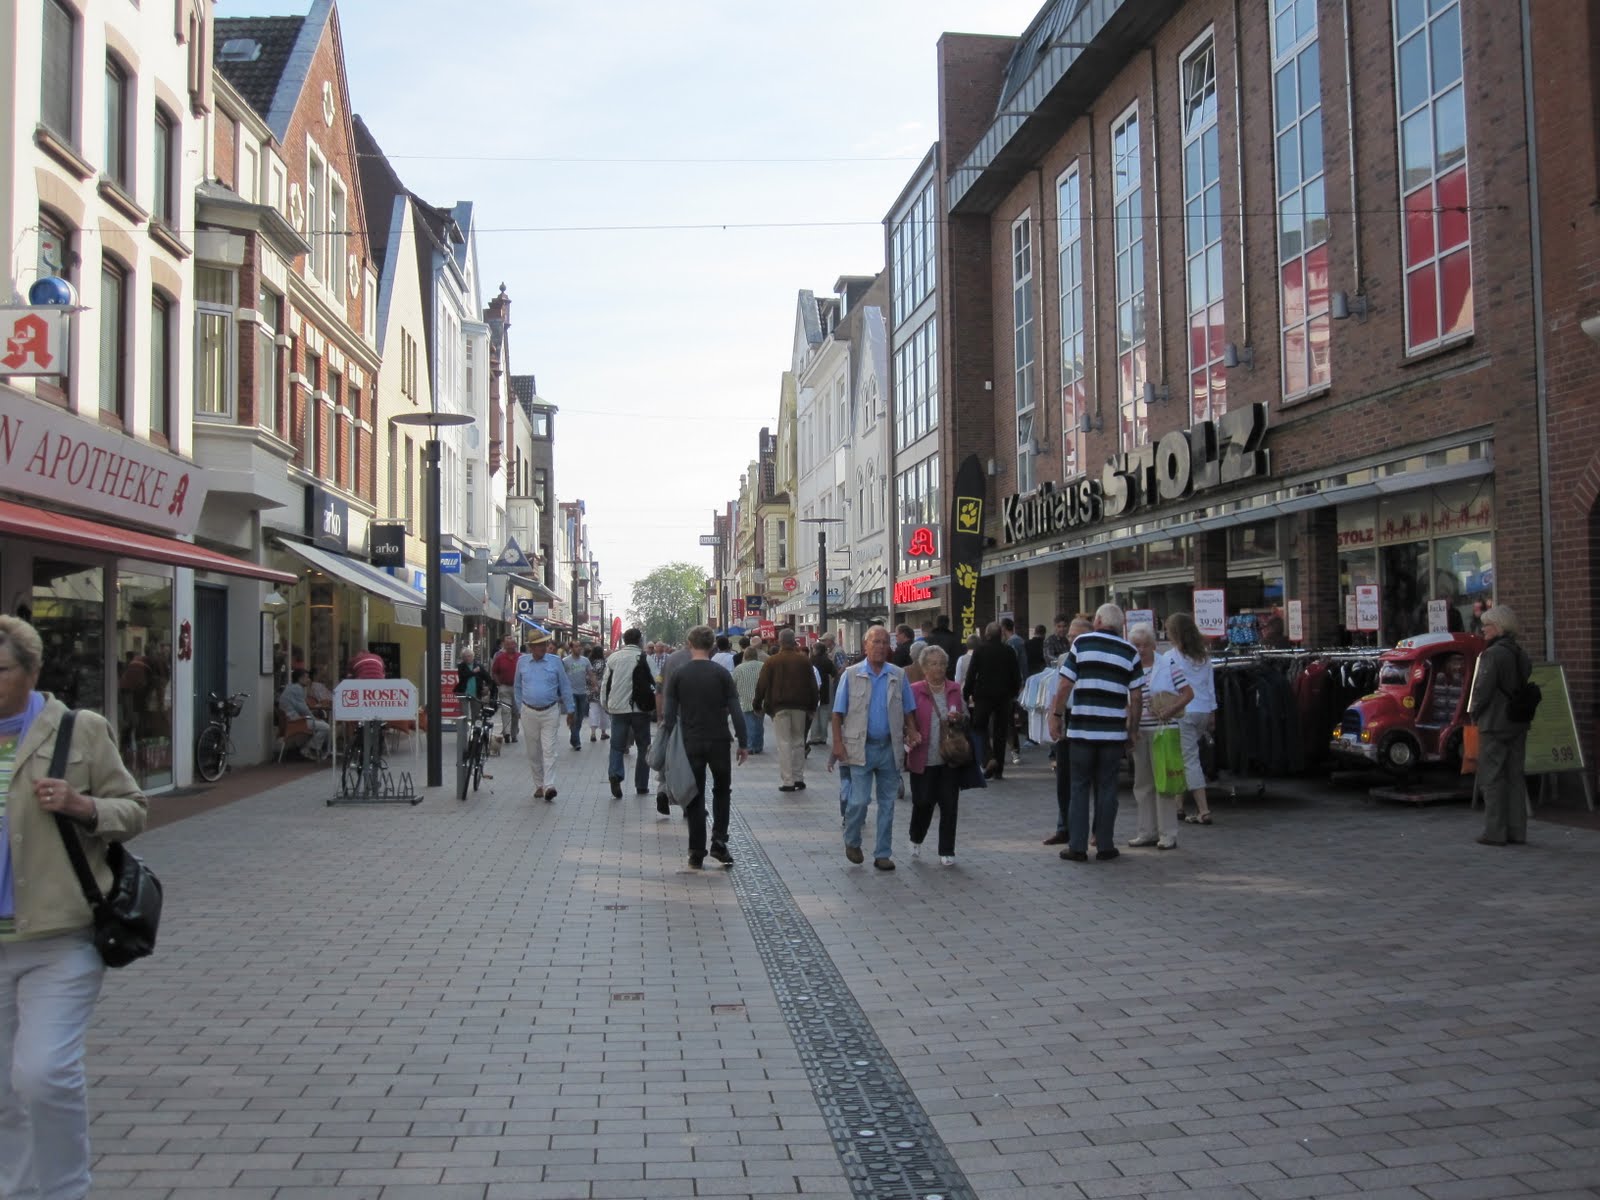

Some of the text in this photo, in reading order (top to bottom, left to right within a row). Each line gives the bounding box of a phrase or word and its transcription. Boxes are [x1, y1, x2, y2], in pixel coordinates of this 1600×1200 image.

[25, 431, 168, 509] APOTHEKE
[1002, 401, 1270, 544] Kaufhaus STOLZ
[324, 503, 341, 536] arko
[375, 543, 399, 554] arko
[440, 558, 459, 566] POLLO
[362, 688, 409, 700] ROSEN
